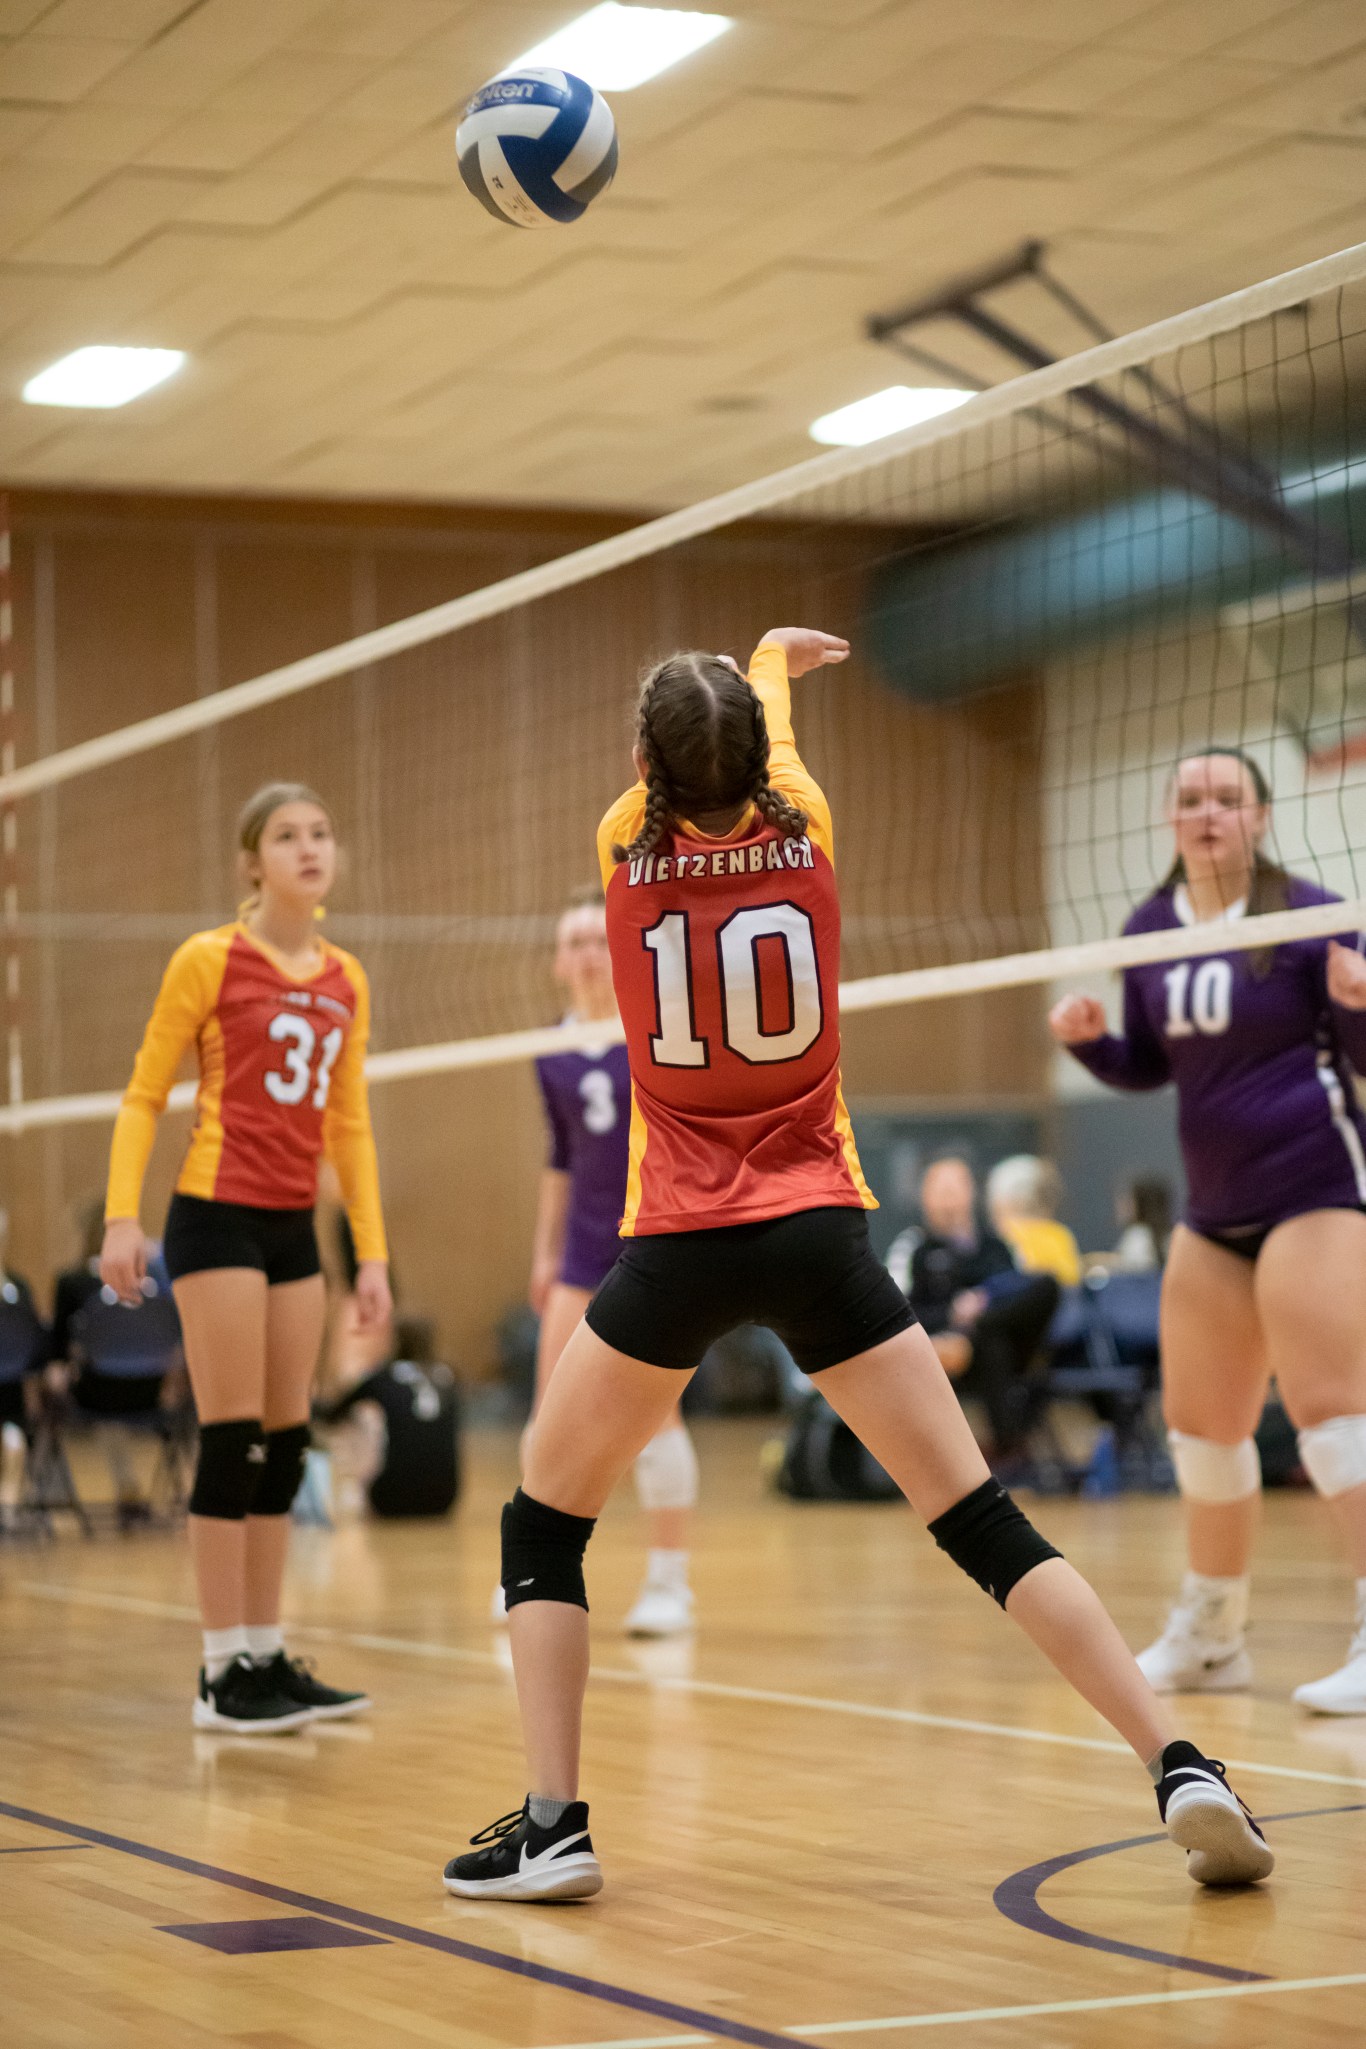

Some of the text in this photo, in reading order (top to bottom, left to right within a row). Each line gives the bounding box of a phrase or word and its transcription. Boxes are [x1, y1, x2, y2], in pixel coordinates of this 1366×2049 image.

[628, 834, 816, 887] DIETZENBACH
[642, 899, 825, 1069] 10
[1164, 957, 1233, 1039] 10
[264, 1012, 343, 1109] 31
[579, 1069, 617, 1134] 3
